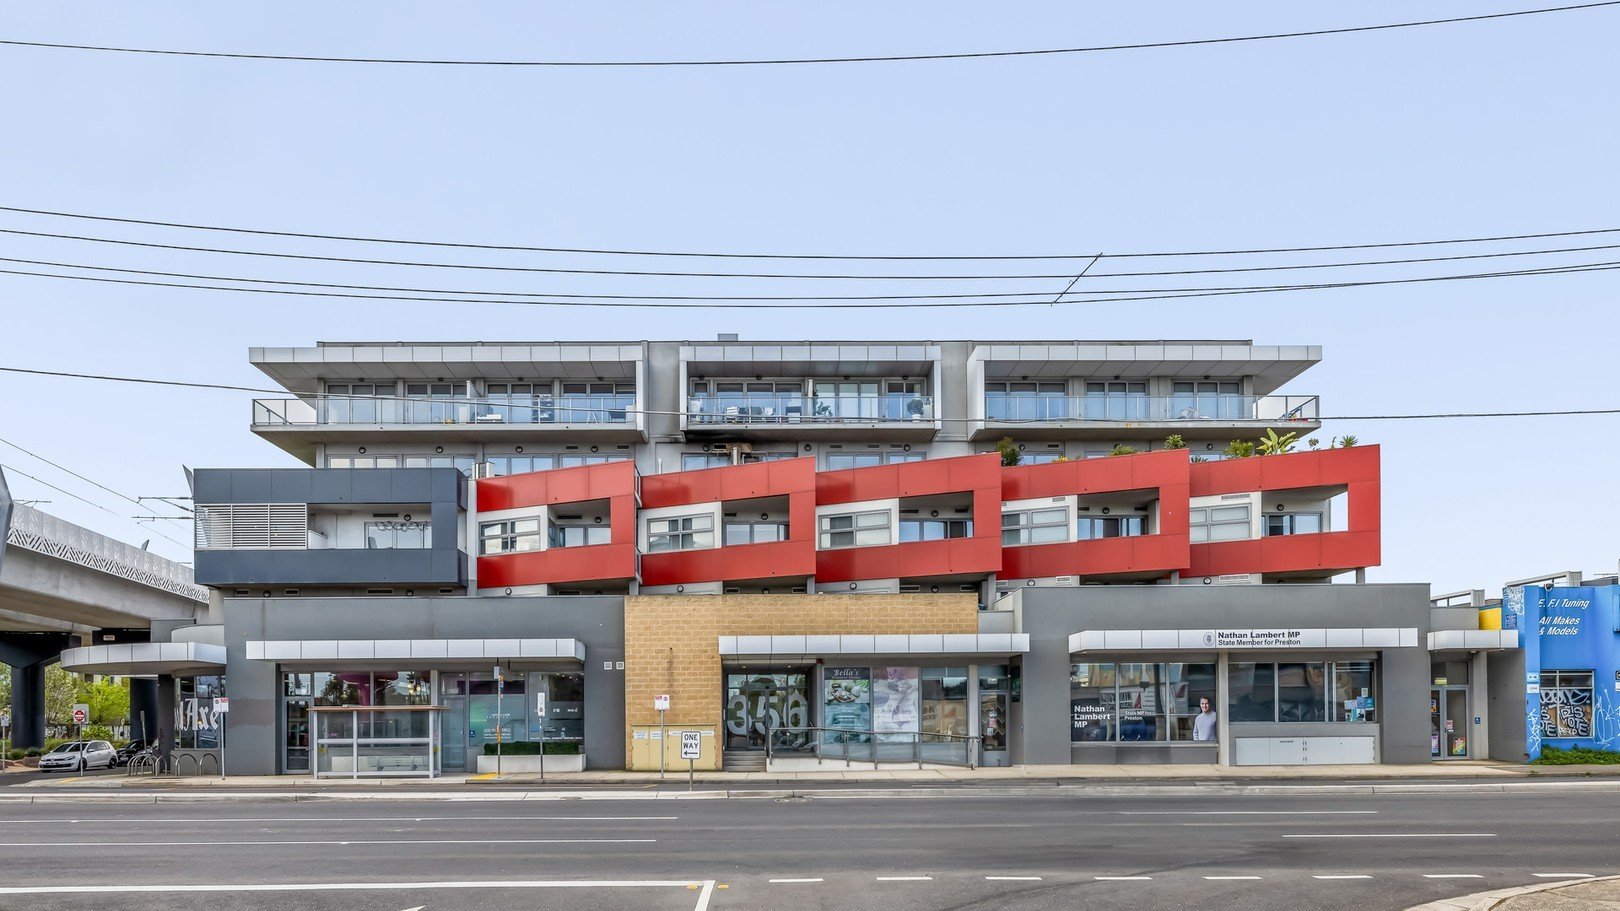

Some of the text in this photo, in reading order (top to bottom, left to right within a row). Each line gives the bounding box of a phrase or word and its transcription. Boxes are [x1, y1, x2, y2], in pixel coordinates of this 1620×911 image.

[1561, 598, 1590, 610] Tuning
[1539, 616, 1580, 625] All Makes
[1250, 631, 1285, 639] Lambert
[1546, 627, 1578, 635] Models
[727, 690, 808, 736] 356
